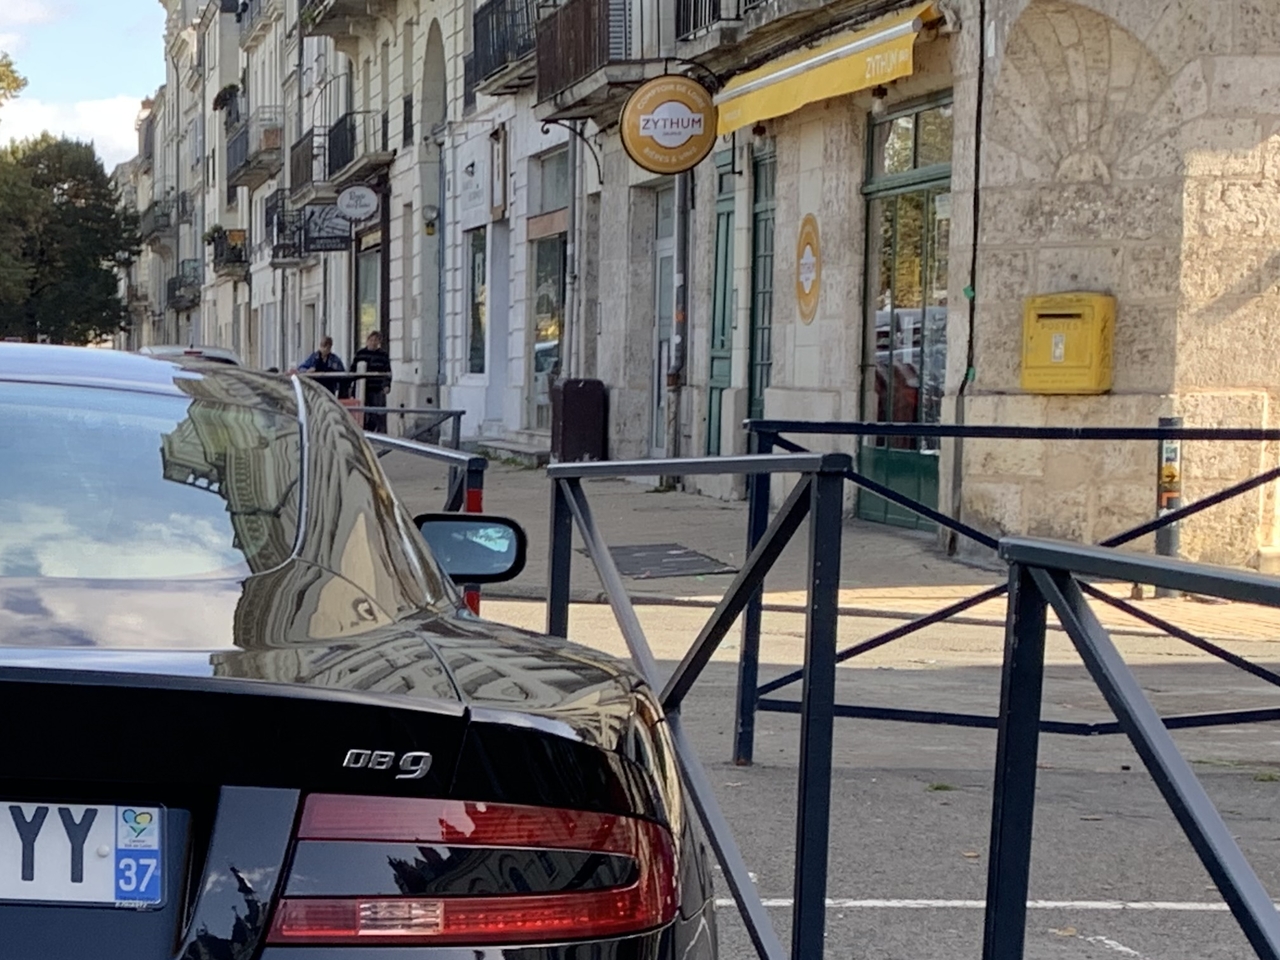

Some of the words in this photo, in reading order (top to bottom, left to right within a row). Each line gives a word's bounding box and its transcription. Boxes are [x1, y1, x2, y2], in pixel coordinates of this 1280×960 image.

[676, 84, 687, 92] DE
[642, 117, 702, 130] ZYTHUM
[342, 749, 433, 780] DB9
[119, 857, 158, 893] 37
